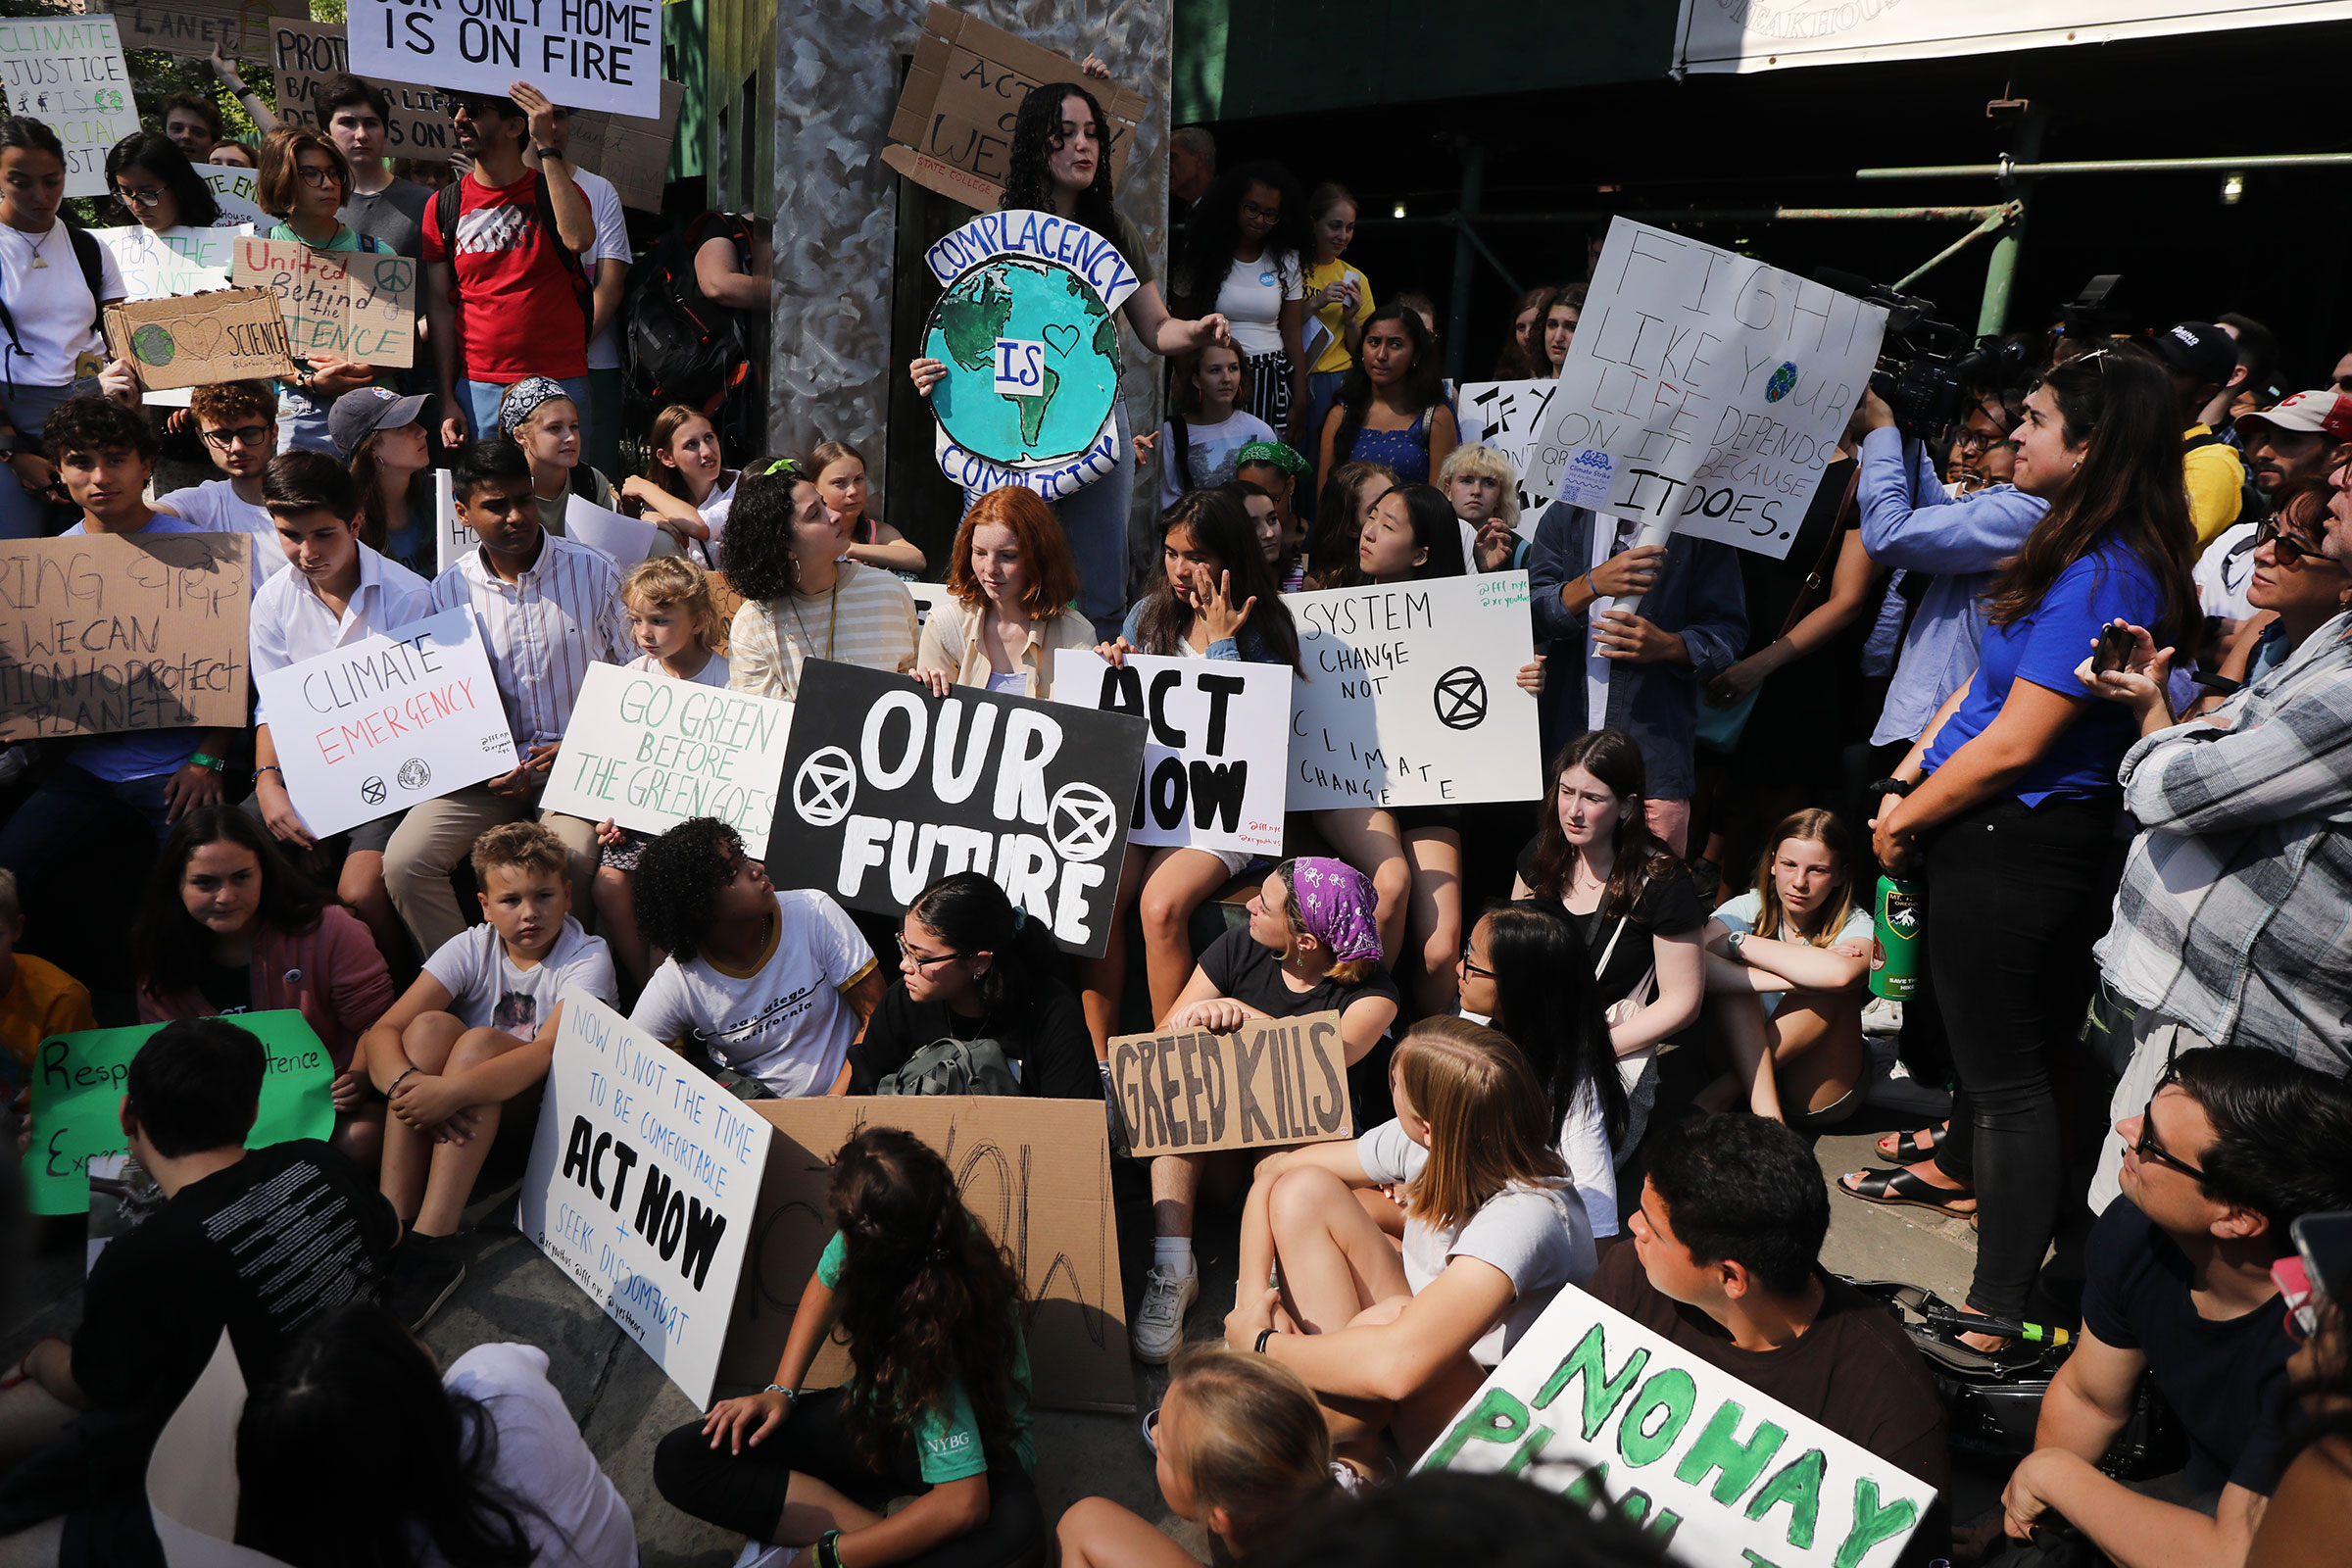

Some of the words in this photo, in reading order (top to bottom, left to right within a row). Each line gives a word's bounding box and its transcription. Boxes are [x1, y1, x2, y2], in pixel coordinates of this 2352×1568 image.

[0, 24, 118, 53] CLIMATE
[385, 8, 435, 55] IS
[459, 18, 521, 69] ON
[543, 34, 633, 86] FIRE
[562, 0, 653, 46] HOME
[4, 56, 125, 86] JUSTICE
[55, 89, 89, 114] IS
[47, 119, 123, 144] OCIAL
[412, 121, 446, 148] ON
[916, 156, 947, 176] STATE
[120, 234, 160, 267] FOR
[160, 236, 218, 270] THE
[245, 241, 349, 282] United
[929, 212, 1137, 305] COMPLACENCY
[270, 271, 378, 310] Behind
[310, 305, 341, 319] the
[1617, 230, 1877, 357] FIGHT
[996, 341, 1042, 387] IS
[1592, 307, 1722, 387] LIKE
[1472, 385, 1517, 442] IF
[1591, 367, 1711, 435] LIFE
[1711, 405, 1836, 471] DEPENDS
[1542, 446, 1569, 466] QR
[1556, 413, 1621, 449] ON
[1622, 428, 1693, 465] IT
[1695, 446, 1816, 498] BECAUSE
[1569, 465, 1592, 475] Climate
[1592, 470, 1611, 479] Strike
[1614, 466, 1689, 518] IT
[1680, 484, 1791, 541] DOES.
[22, 616, 75, 659] WE
[79, 615, 161, 654] CAN
[1302, 591, 1433, 641] SYSTEM
[303, 632, 443, 713] CLIMATE
[1320, 640, 1409, 676] CHANGE
[1097, 665, 1246, 758] ACT
[1342, 675, 1390, 700] NOT
[316, 676, 476, 765] EMERGENCY
[619, 680, 674, 728] GO
[679, 692, 780, 755] GREEN
[635, 731, 740, 782] BEFORE
[860, 689, 1064, 825] OUR
[1293, 710, 1455, 800] CLIMATE
[573, 752, 628, 801] THE
[627, 766, 710, 818] GREEN
[708, 783, 778, 837] GOES
[1301, 759, 1392, 806] CHANGE
[836, 814, 1106, 946] FUTURE
[728, 1014, 760, 1030] san
[763, 986, 806, 1014] diego
[732, 1000, 813, 1045] california
[572, 1004, 612, 1053] NOW
[614, 1035, 632, 1076] IS
[632, 1051, 667, 1096] NOT
[673, 1078, 707, 1125] THE
[713, 1104, 755, 1165] TIME
[1115, 1031, 1227, 1149] GREED
[1231, 1021, 1344, 1144] KILLS
[589, 1071, 608, 1106] TO
[613, 1089, 634, 1124] BE
[640, 1110, 728, 1198] COMFORTABLE
[555, 1202, 595, 1255] SEEK
[563, 1114, 638, 1213] ACT
[634, 1162, 728, 1293] NOW
[1530, 1321, 1698, 1469] NO
[1674, 1397, 1919, 1568] HAY
